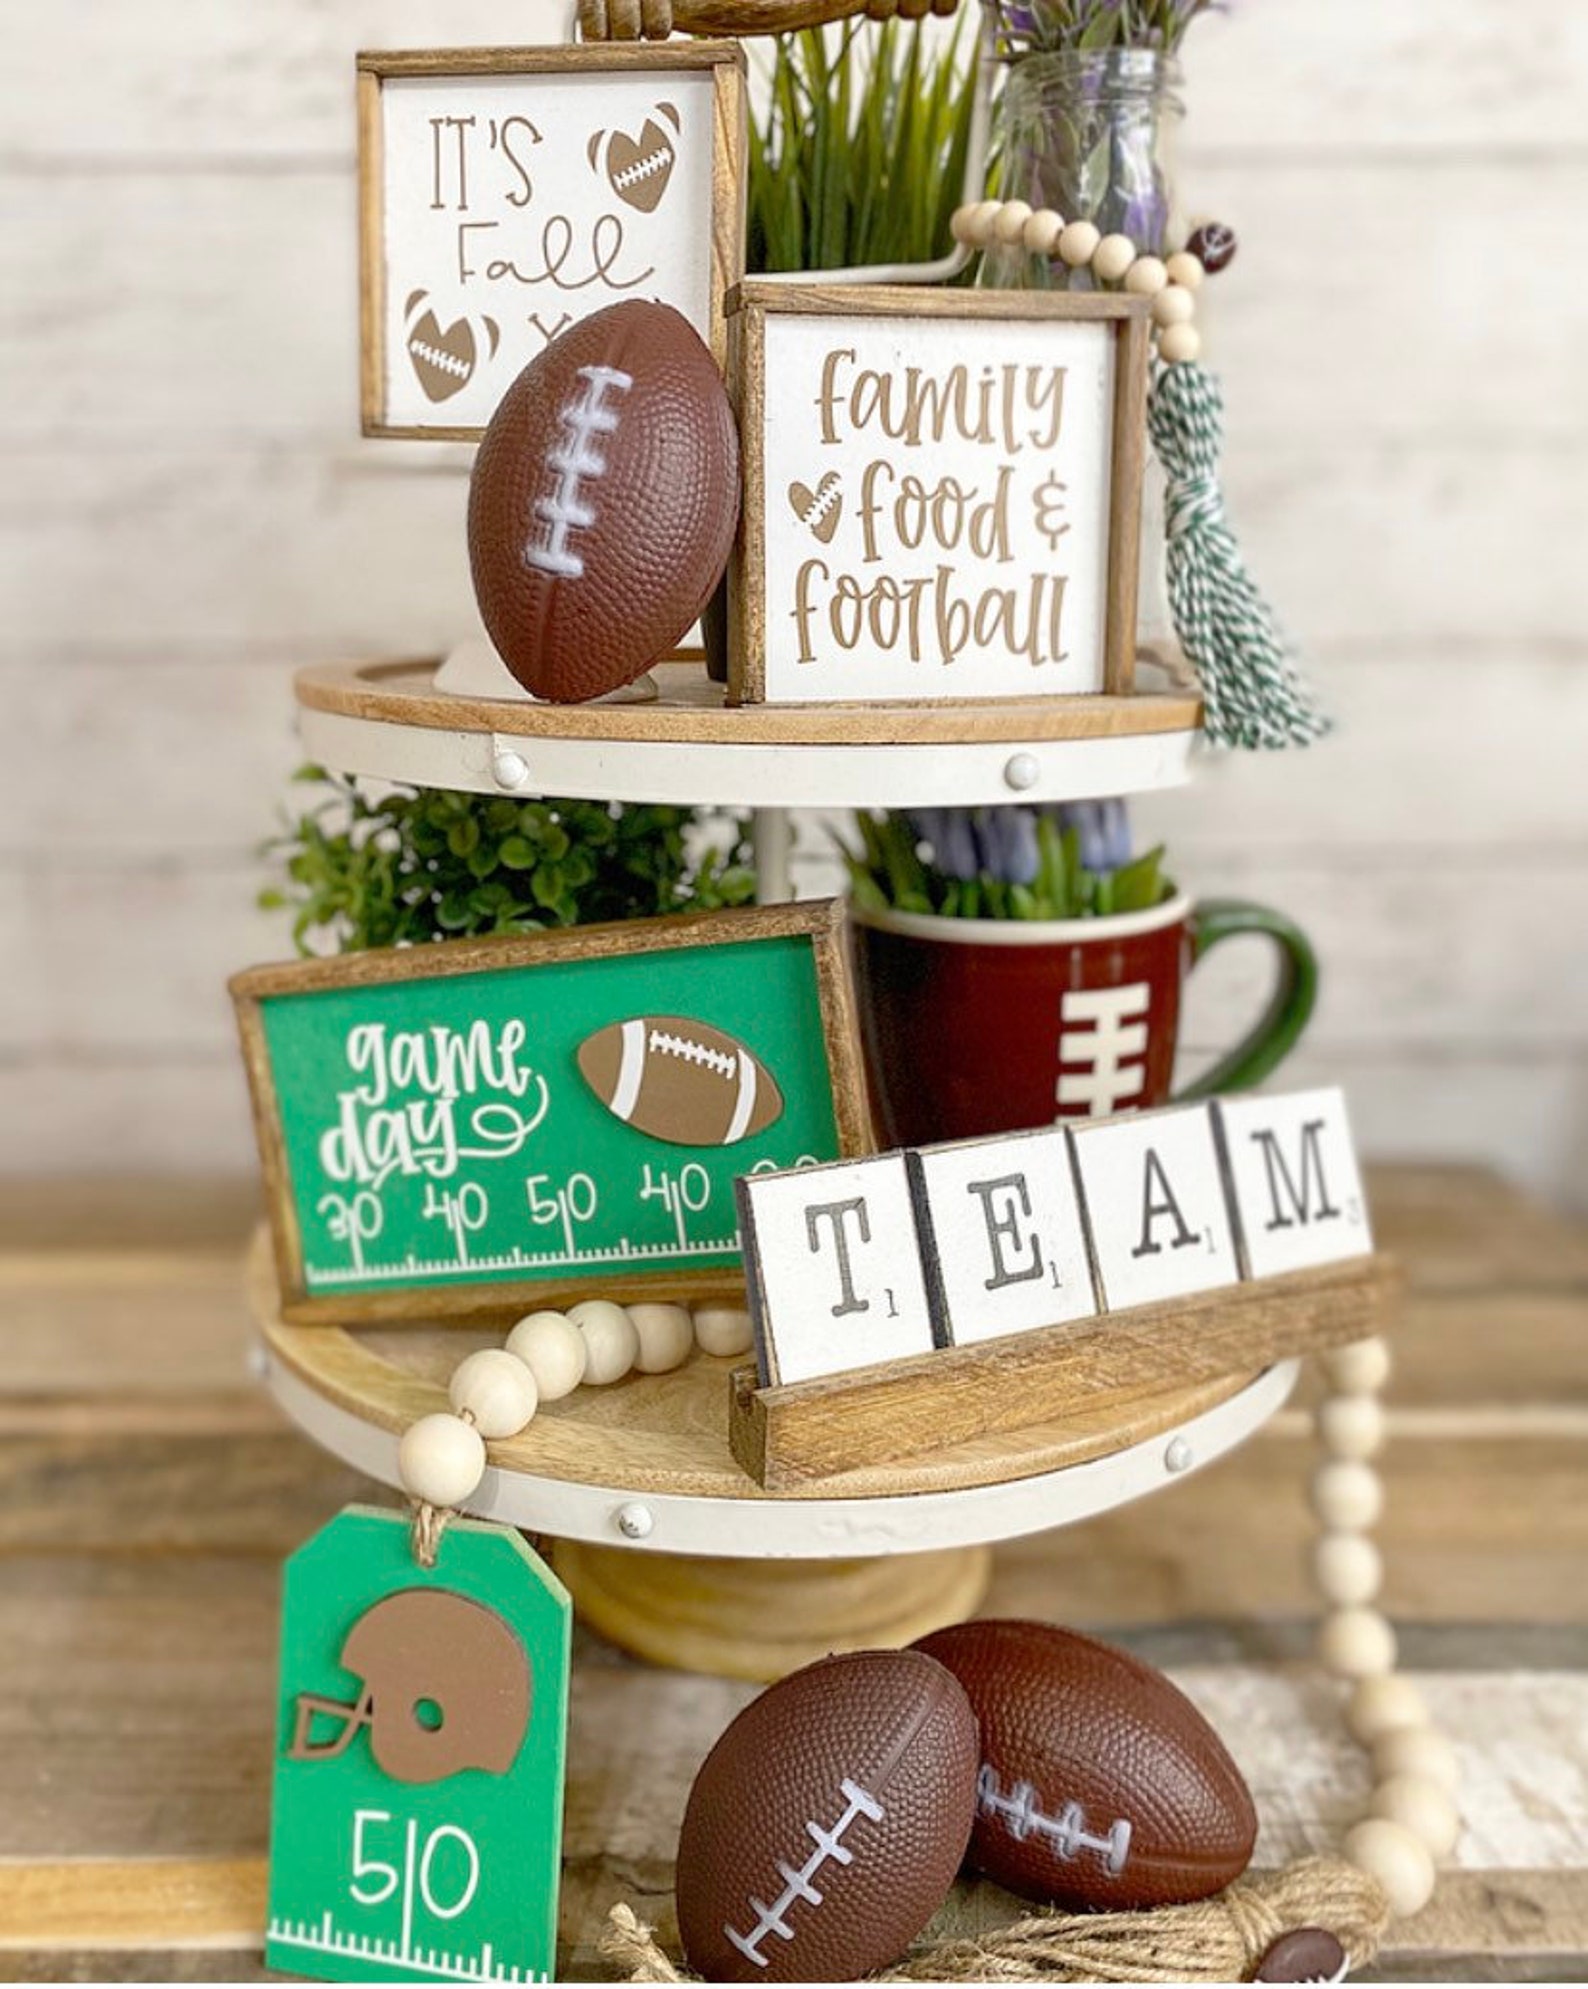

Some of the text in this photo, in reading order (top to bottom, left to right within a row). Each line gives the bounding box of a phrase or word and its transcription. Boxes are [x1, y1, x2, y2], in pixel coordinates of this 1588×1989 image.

[429, 116, 544, 211] IT'S
[458, 214, 655, 290] Fall
[814, 348, 1068, 455] family
[856, 459, 1071, 563] food &
[789, 559, 1070, 666] football
[346, 1019, 532, 1105] game
[318, 1089, 549, 1189] day
